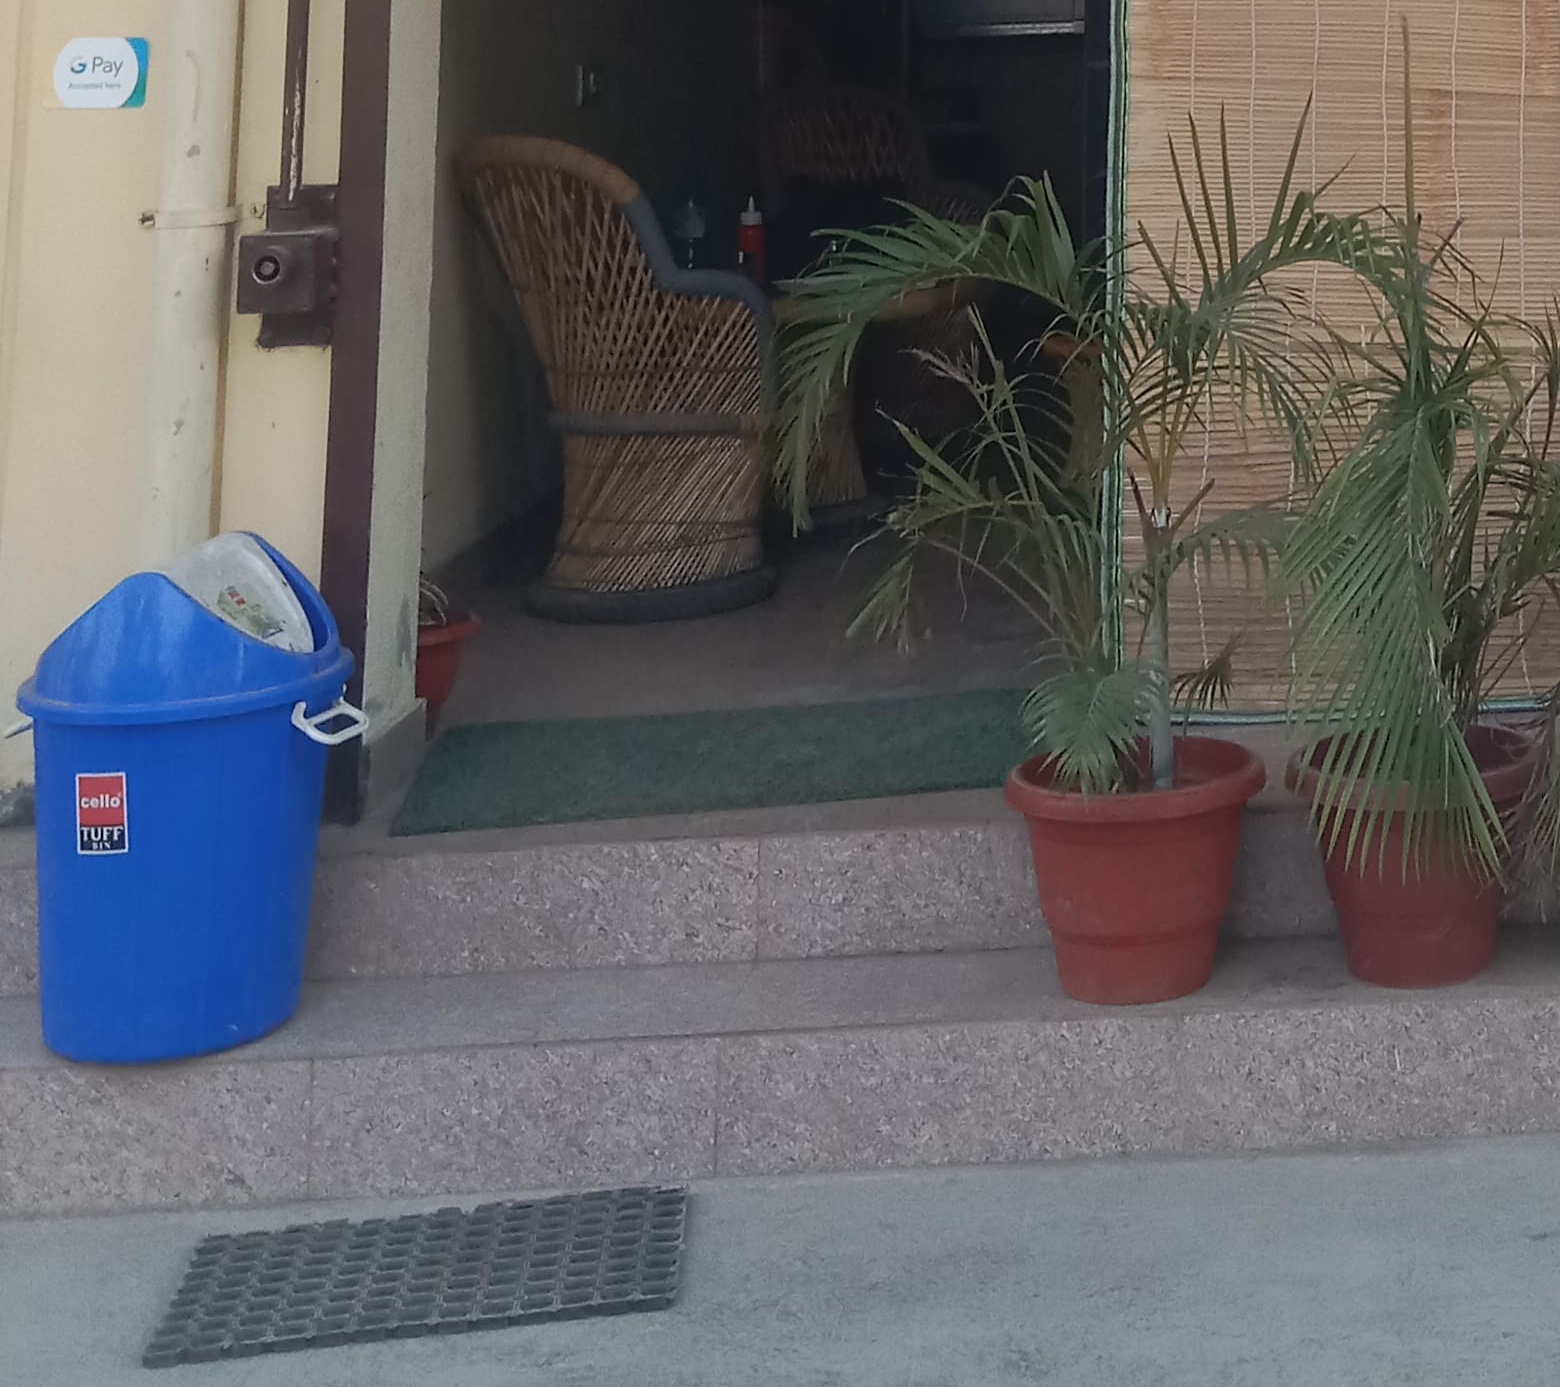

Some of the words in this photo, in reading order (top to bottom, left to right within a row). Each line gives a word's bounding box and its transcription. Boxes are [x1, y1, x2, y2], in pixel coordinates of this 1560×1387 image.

[92, 56, 123, 77] Pay
[81, 794, 120, 808] cello
[81, 827, 123, 841] TUFF
[92, 842, 111, 850] BIN
